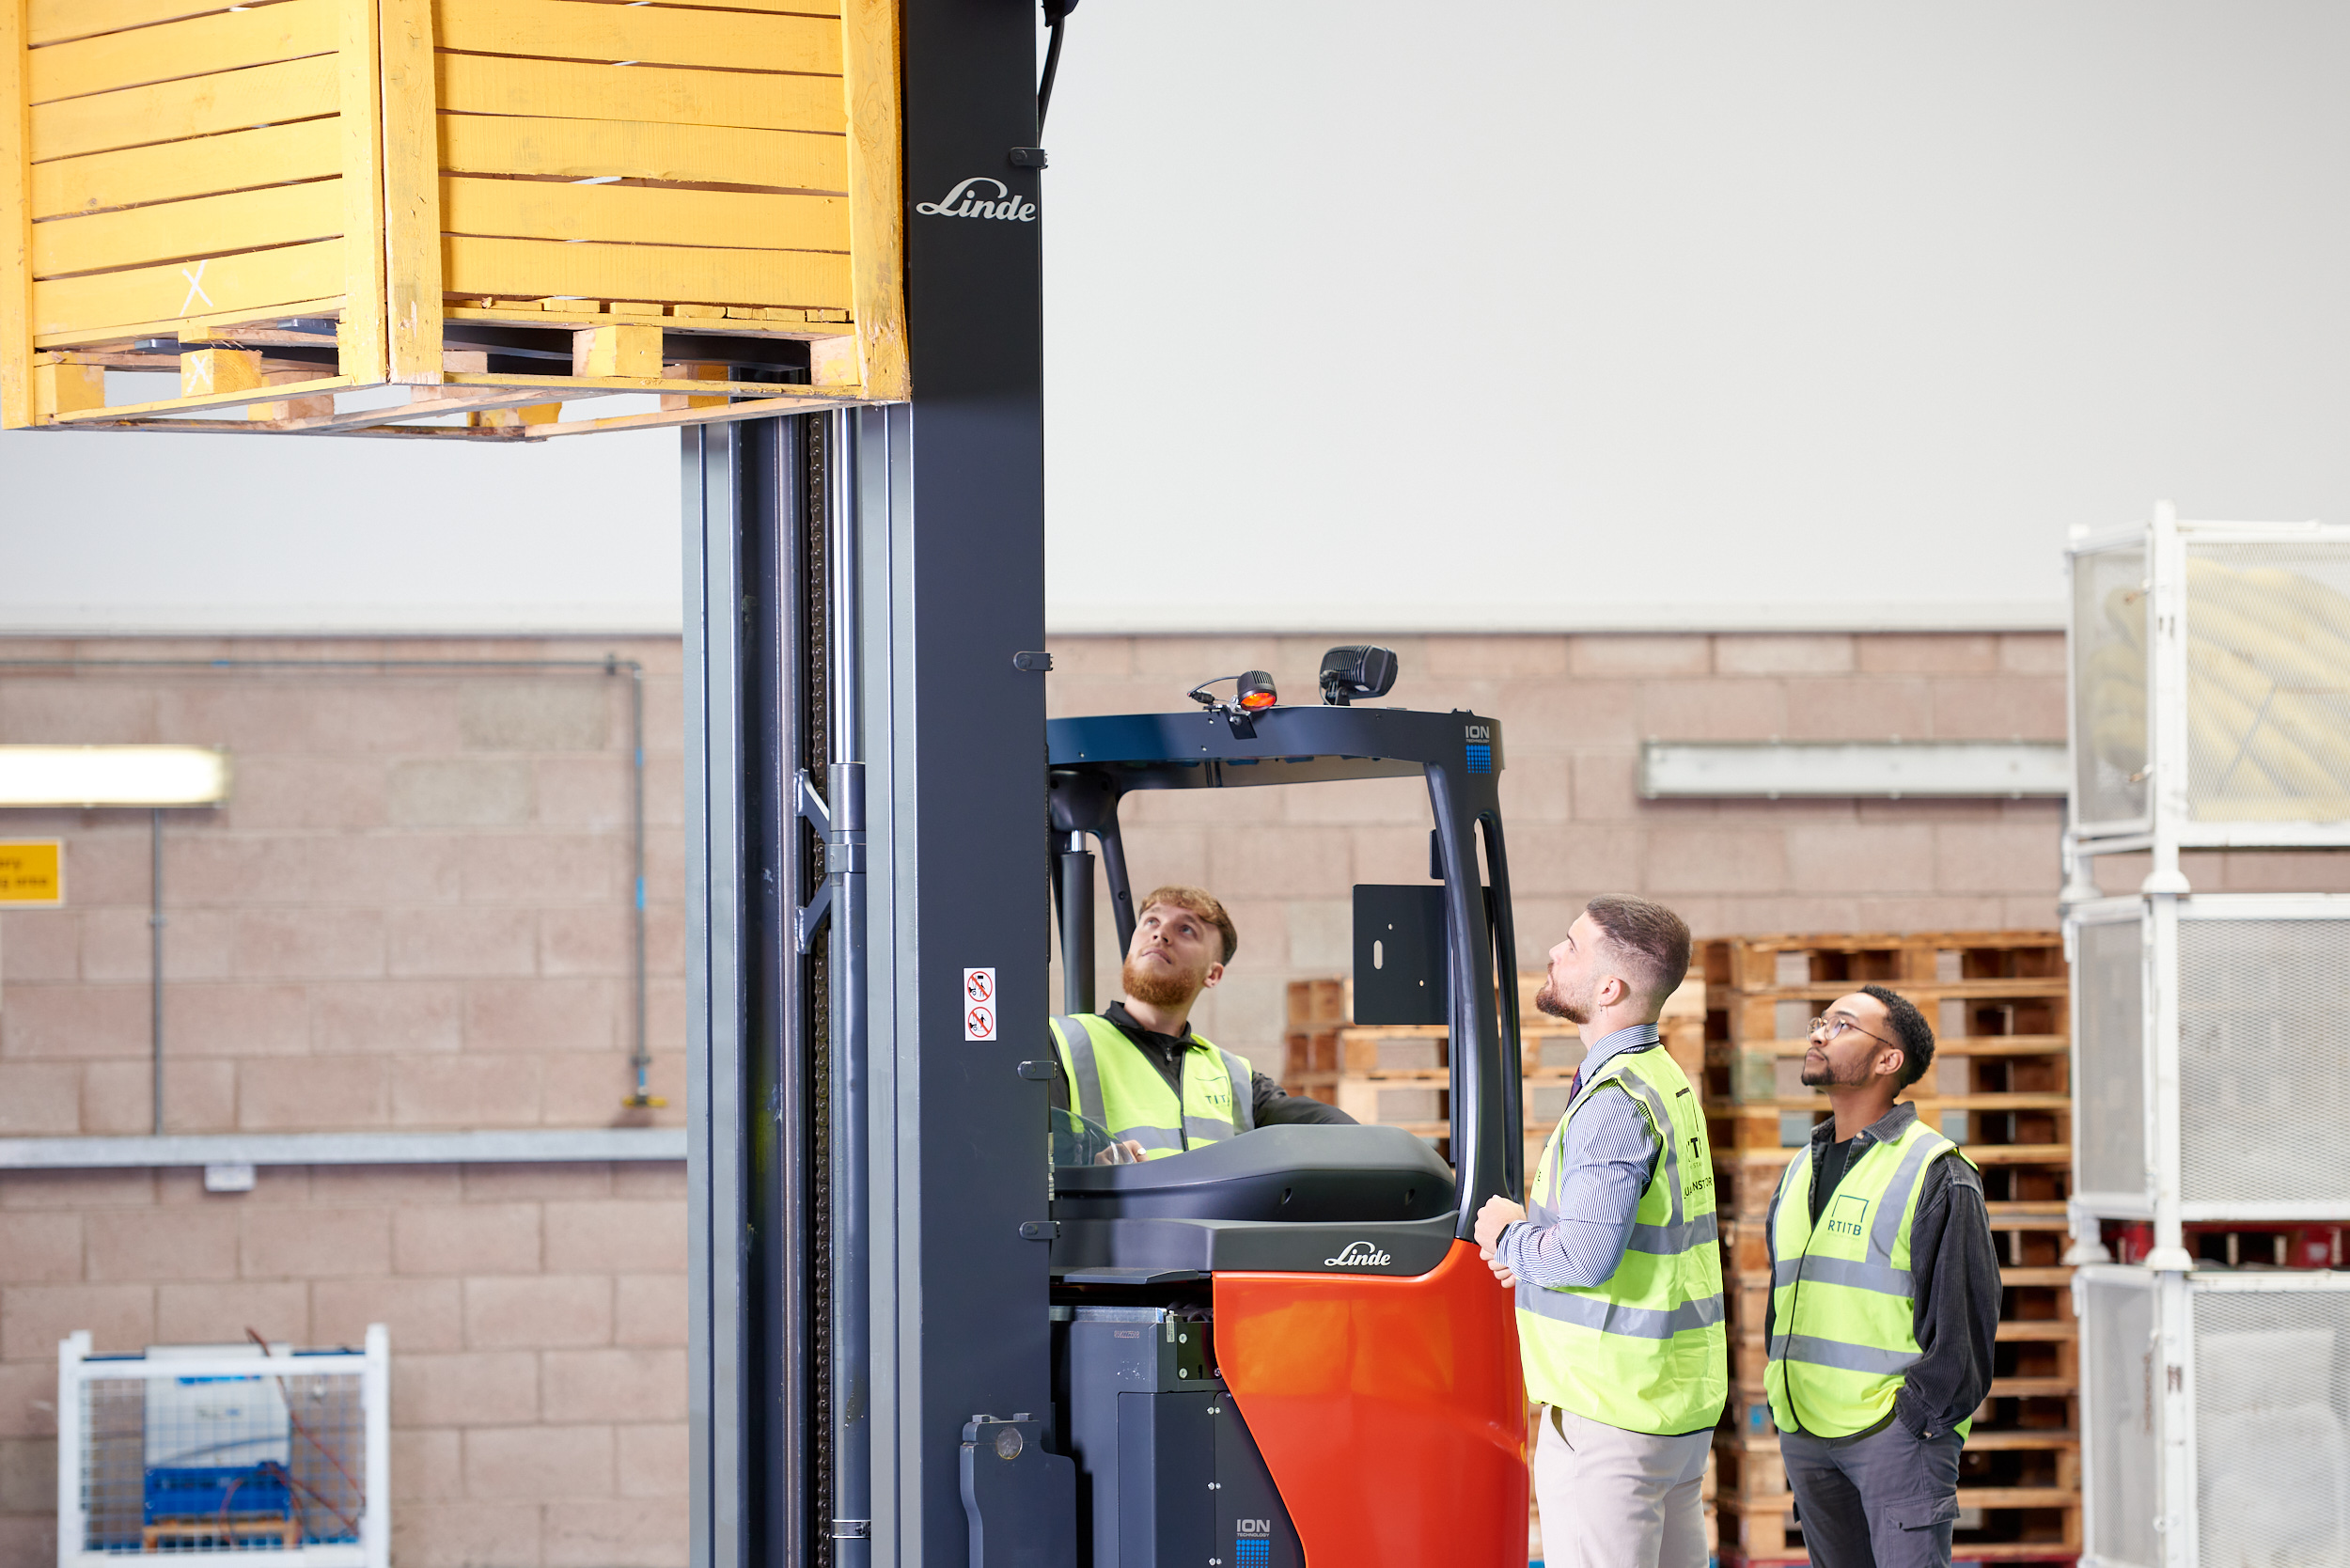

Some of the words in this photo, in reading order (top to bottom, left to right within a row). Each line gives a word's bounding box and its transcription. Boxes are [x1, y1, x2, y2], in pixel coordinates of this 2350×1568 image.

[916, 177, 1036, 222] Linde
[1465, 725, 1489, 739] ION
[1827, 1219, 1862, 1236] RTITB
[1324, 1240, 1391, 1266] Linde
[1236, 1519, 1271, 1532] ION
